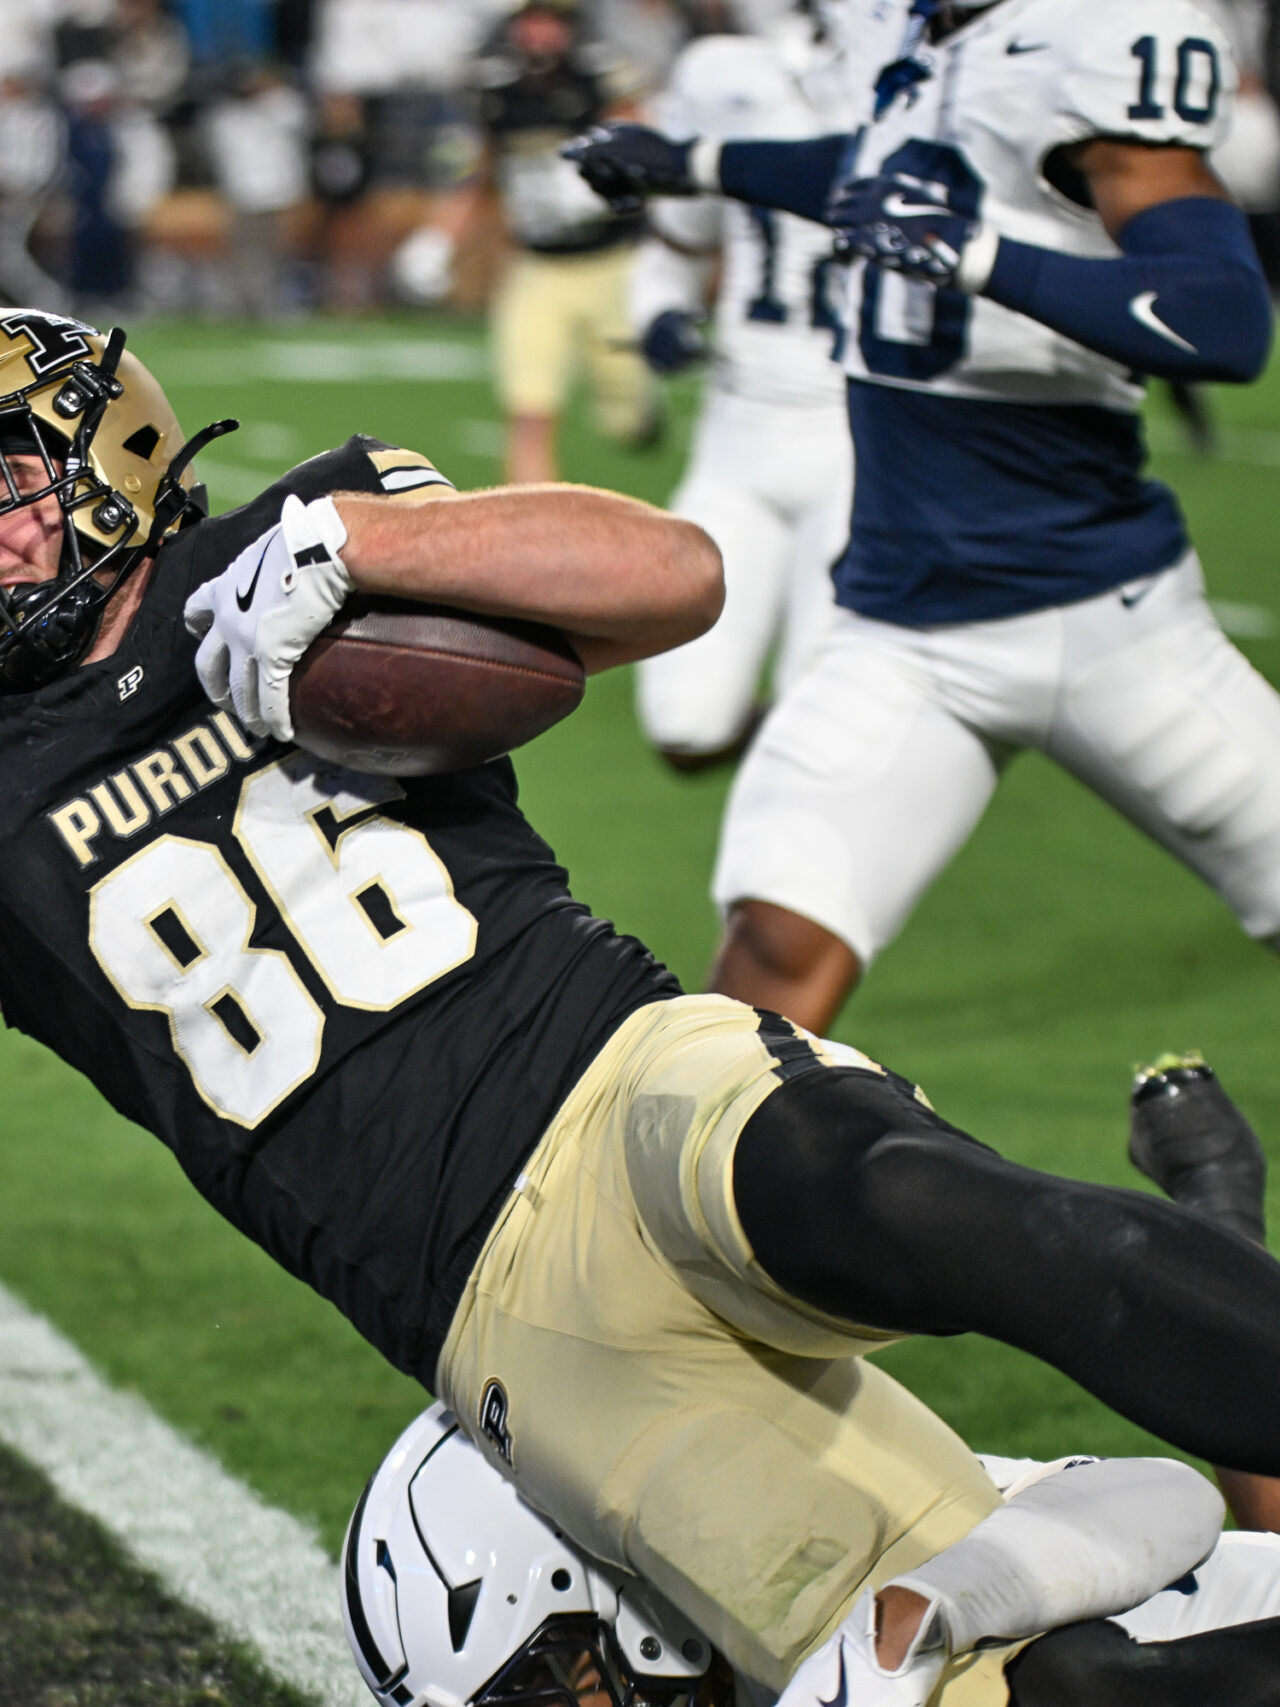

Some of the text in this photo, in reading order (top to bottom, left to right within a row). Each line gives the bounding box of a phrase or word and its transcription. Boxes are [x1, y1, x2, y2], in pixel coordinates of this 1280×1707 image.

[1127, 36, 1220, 125] 10
[117, 665, 144, 701] P
[46, 711, 256, 870] PURD
[88, 750, 480, 1130] 86
